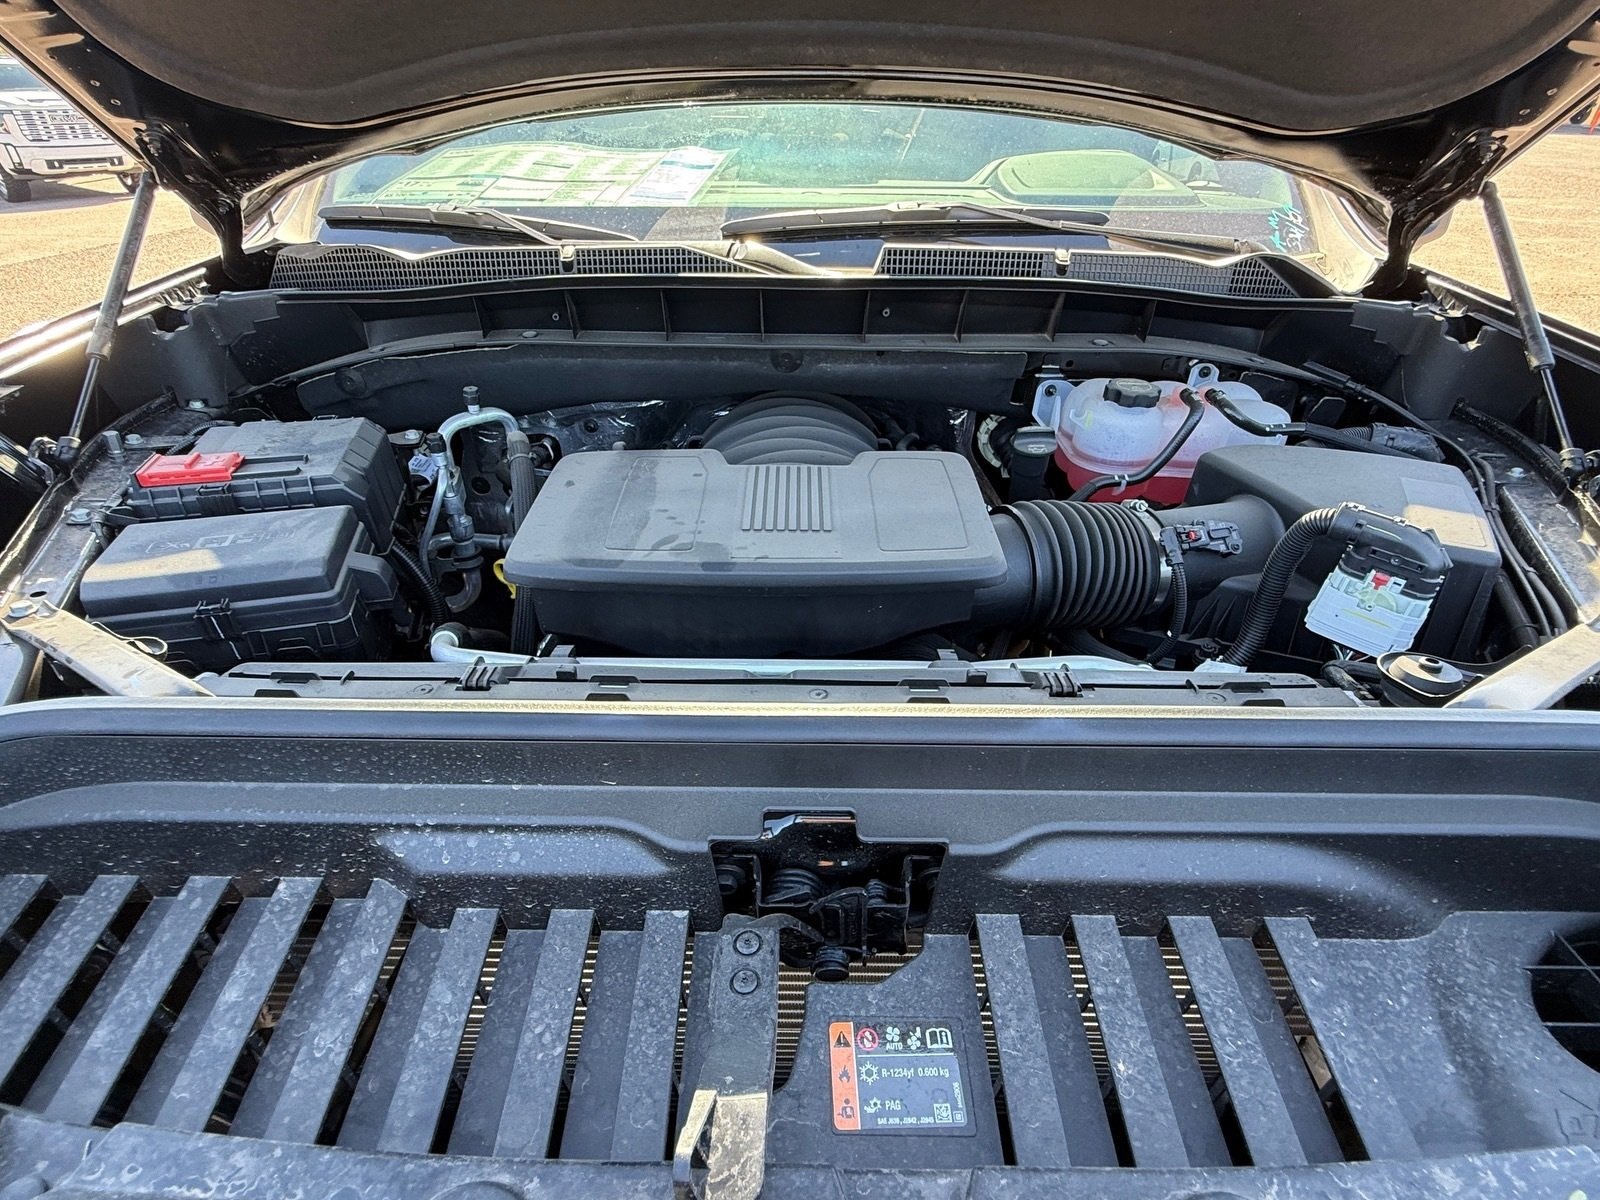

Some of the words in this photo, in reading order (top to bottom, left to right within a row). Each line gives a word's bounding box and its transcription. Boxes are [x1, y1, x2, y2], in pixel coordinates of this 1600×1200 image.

[886, 1042, 903, 1050] AUTO
[881, 1067, 914, 1079] R-1234yf
[918, 1067, 938, 1077] 0.600
[939, 1066, 949, 1078] kg
[885, 1100, 902, 1111] PAG
